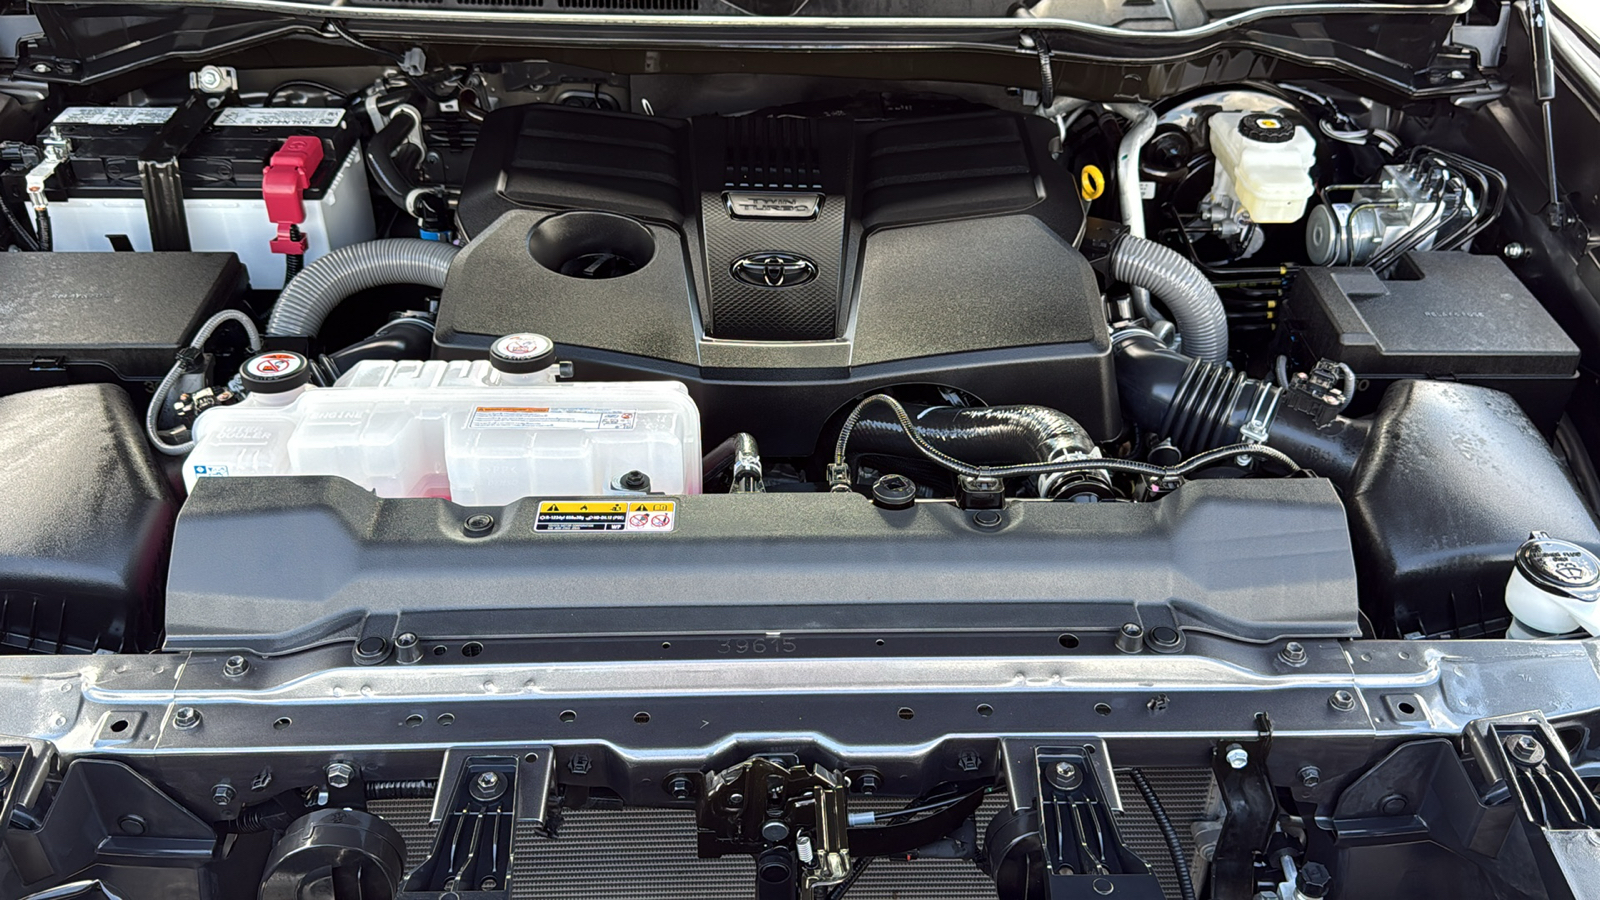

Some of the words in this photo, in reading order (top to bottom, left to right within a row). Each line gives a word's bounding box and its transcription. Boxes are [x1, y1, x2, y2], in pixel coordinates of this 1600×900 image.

[748, 197, 797, 205] TWIN
[738, 204, 809, 212] TURBO
[309, 410, 364, 419] ENGINE
[216, 431, 272, 440] COOLER
[717, 637, 797, 654] 39615
